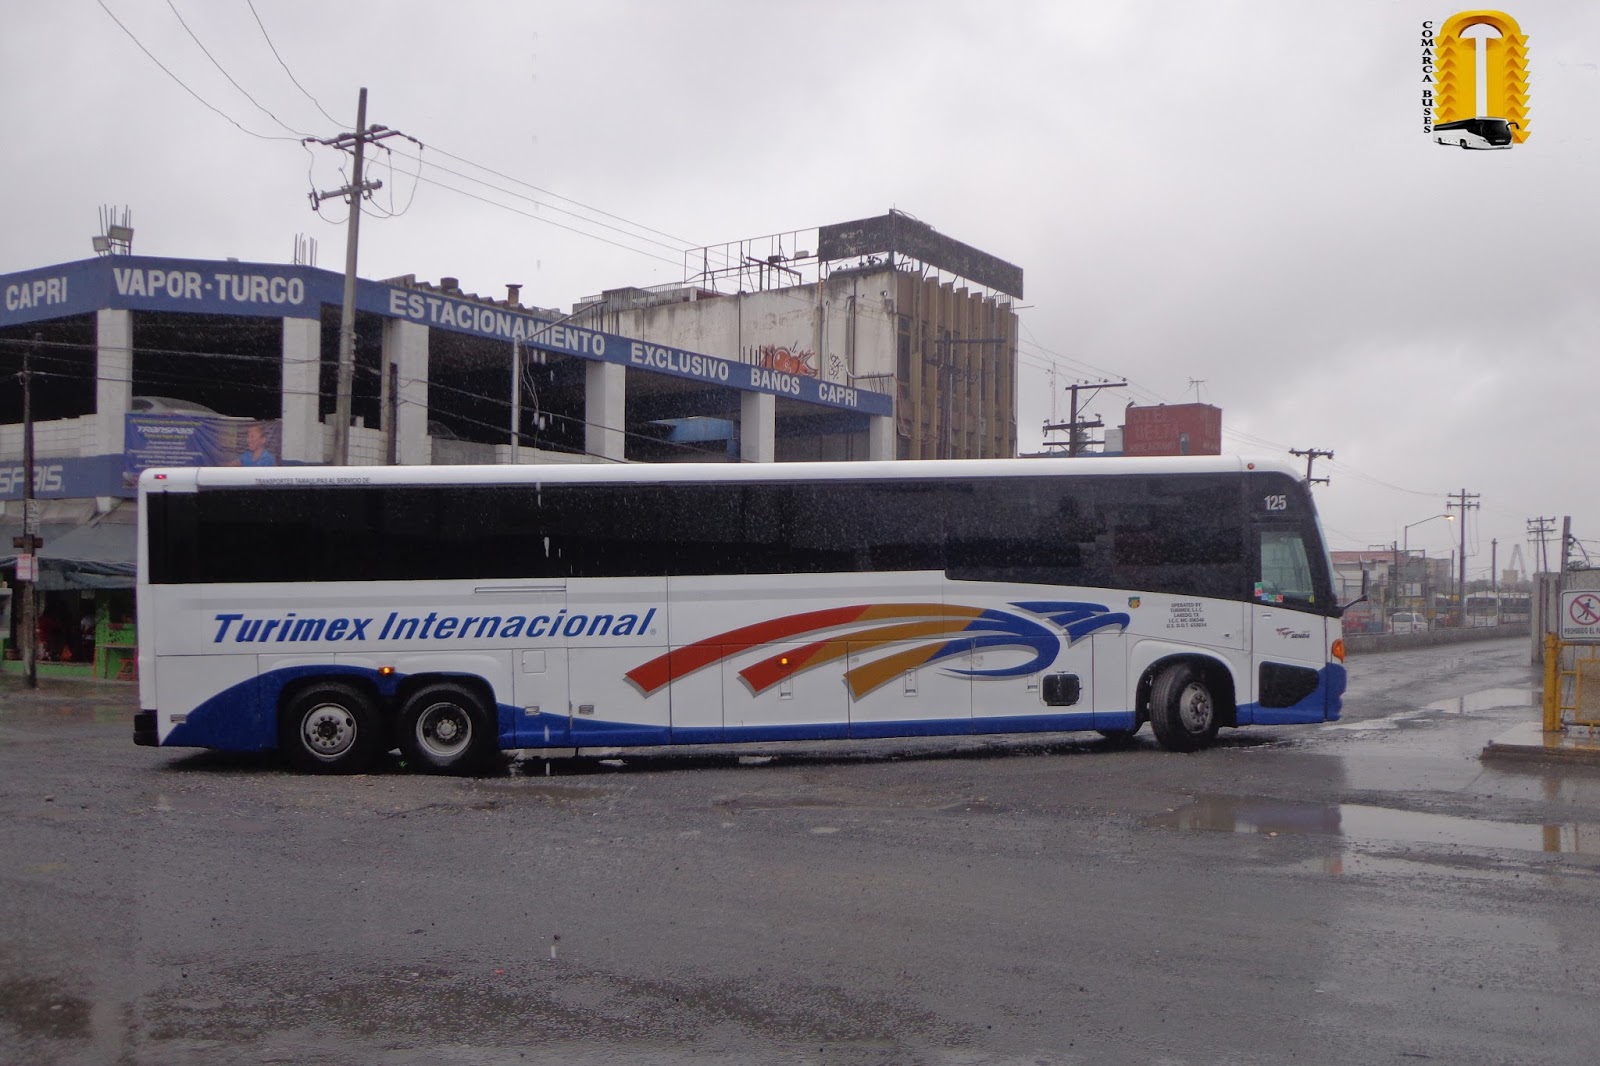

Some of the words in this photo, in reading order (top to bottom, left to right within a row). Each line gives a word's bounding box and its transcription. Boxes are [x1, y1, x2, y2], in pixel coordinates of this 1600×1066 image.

[5, 276, 68, 311] CAPRI
[389, 288, 606, 357] ESTACIONAMIENTO
[630, 341, 729, 382] EXCLUSIVO
[750, 367, 800, 395] BAÑOS
[818, 382, 858, 408] CAPRI
[1263, 494, 1287, 511] 125
[213, 613, 375, 643] Turimex
[377, 607, 657, 640] Internacional
